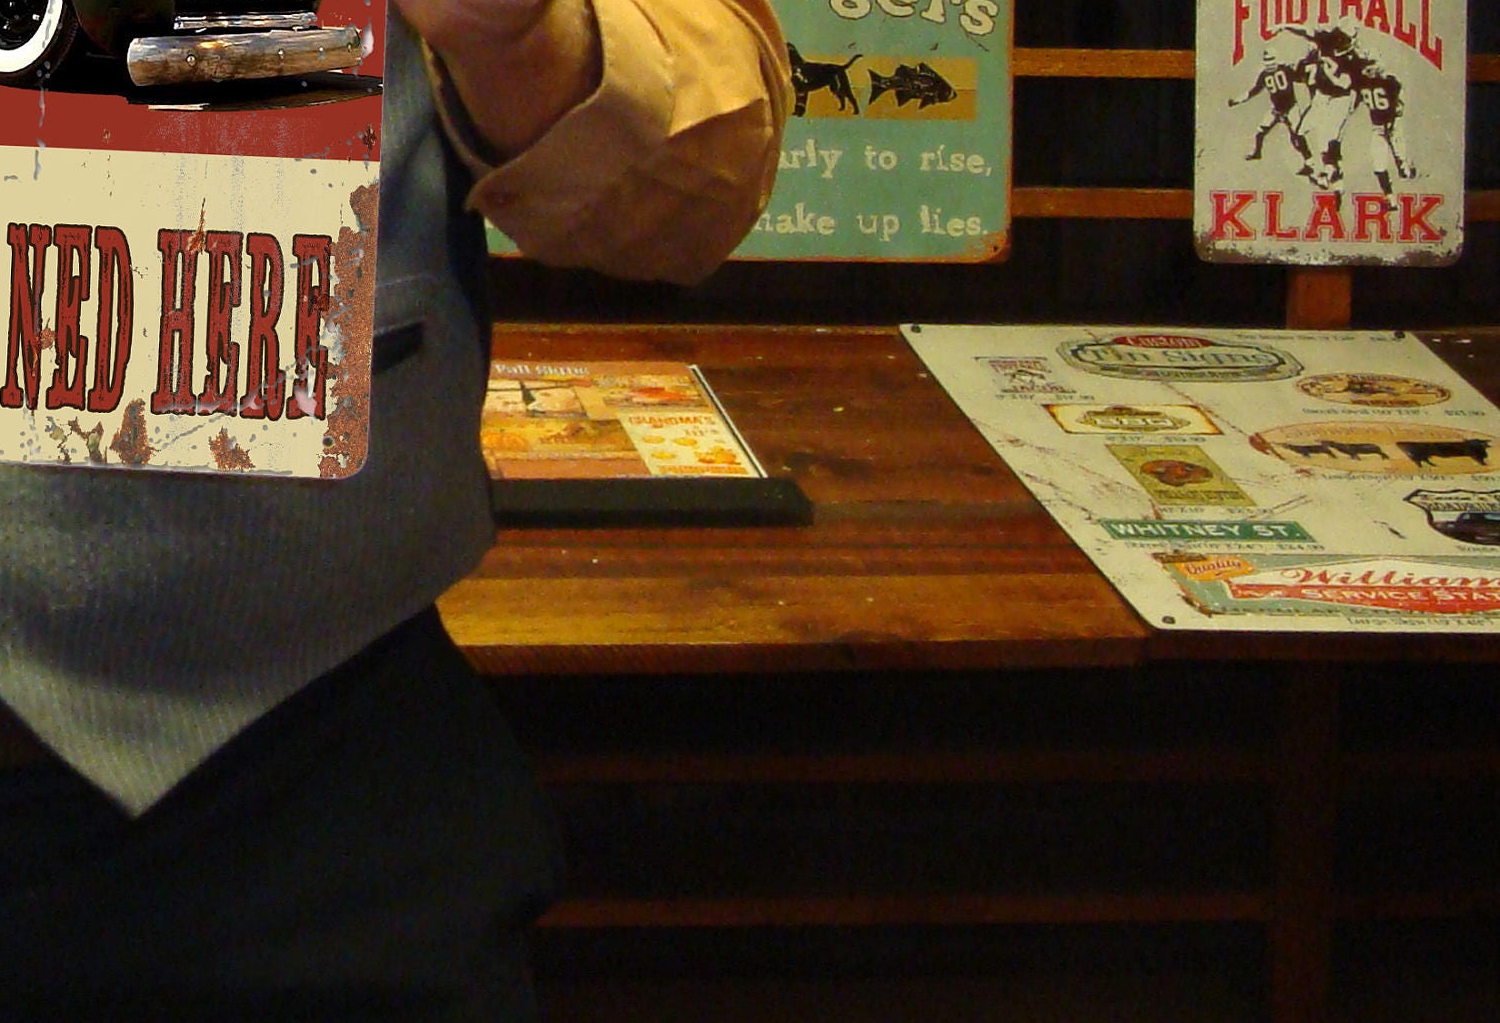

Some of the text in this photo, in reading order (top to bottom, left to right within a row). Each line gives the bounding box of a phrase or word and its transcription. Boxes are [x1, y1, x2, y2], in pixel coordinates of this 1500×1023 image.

[864, 144, 898, 171] to
[856, 213, 901, 243] up
[1209, 188, 1445, 244] KLARK
[149, 227, 335, 423] HERE
[1111, 521, 1302, 537] WHITNEY ST.
[1301, 588, 1500, 603] SERVICE STAT
